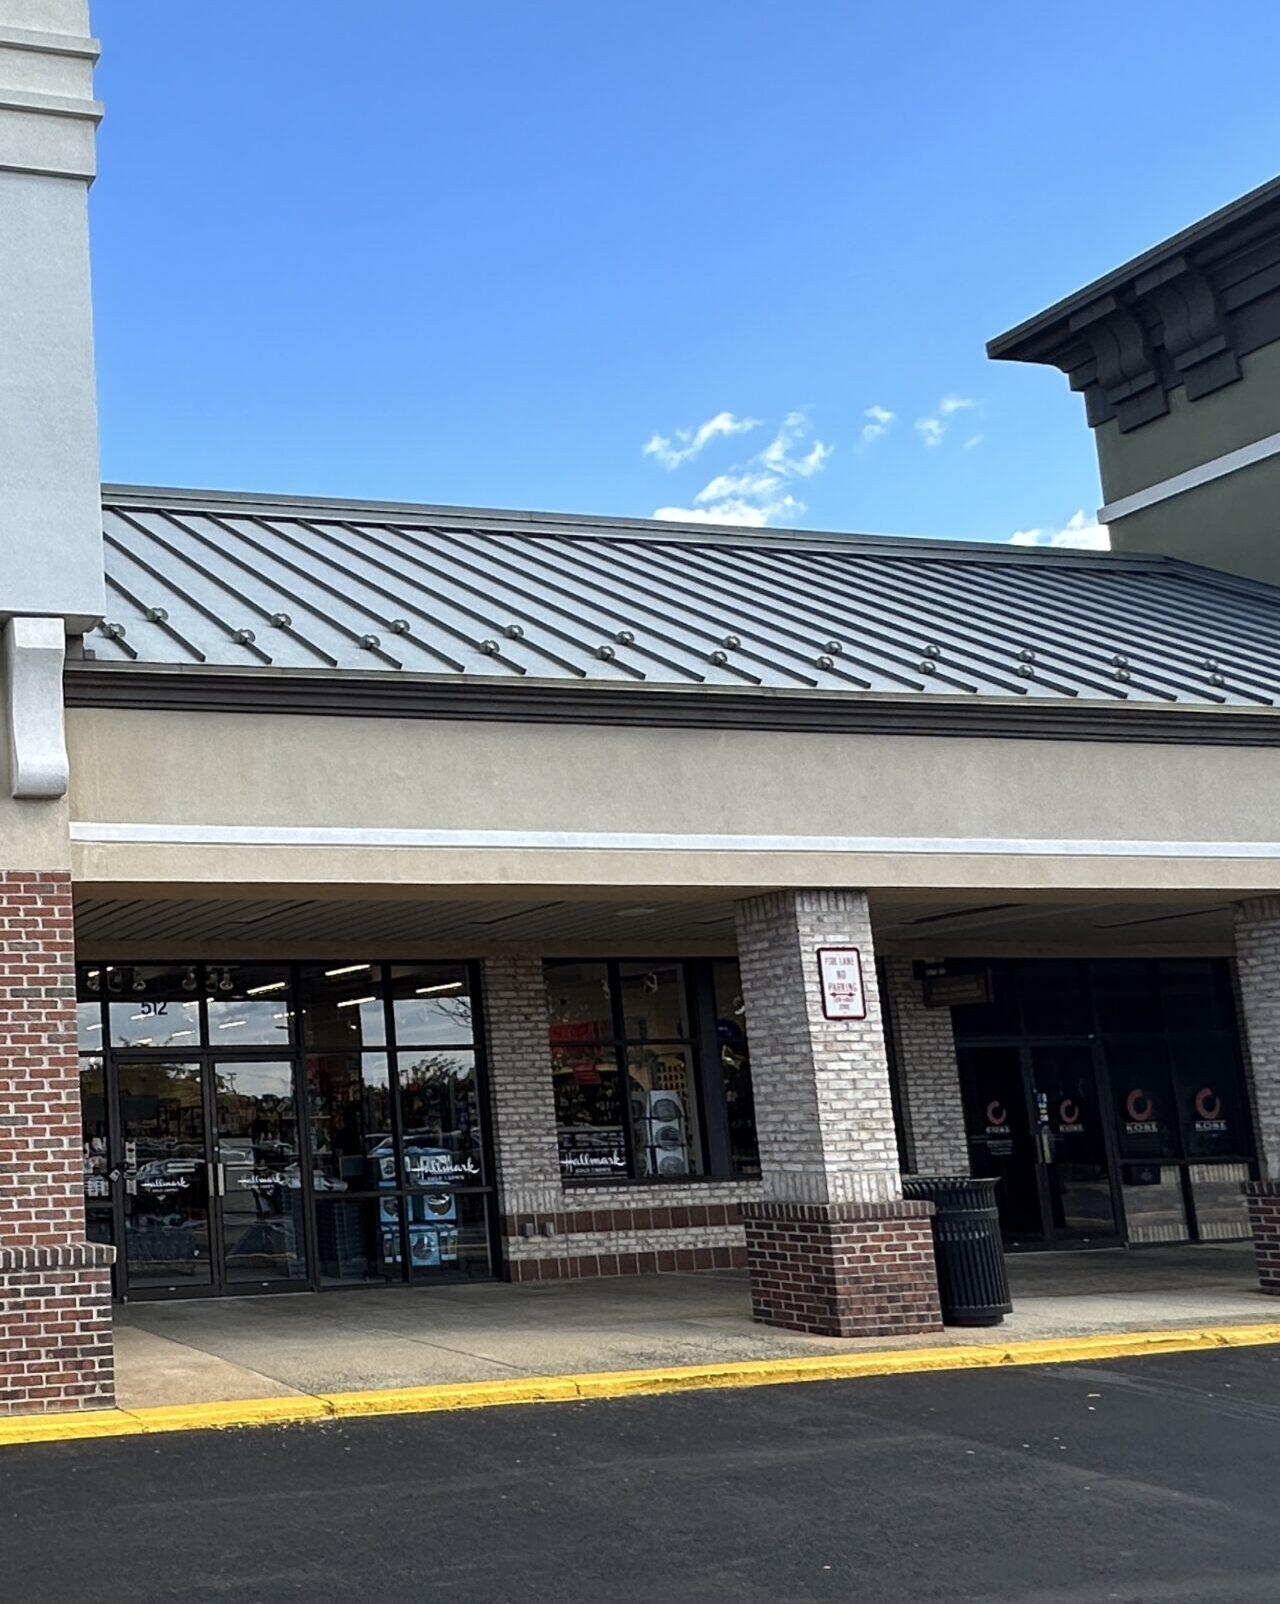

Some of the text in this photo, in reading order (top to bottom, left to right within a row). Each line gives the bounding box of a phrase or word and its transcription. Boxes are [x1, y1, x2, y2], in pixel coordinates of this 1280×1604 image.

[824, 957, 855, 966] FIRE LANE
[836, 970, 847, 980] NO
[828, 983, 857, 992] PARKING
[140, 1001, 168, 1016] 512
[559, 1149, 627, 1173] Hallmark
[410, 1156, 481, 1180] Hallmark
